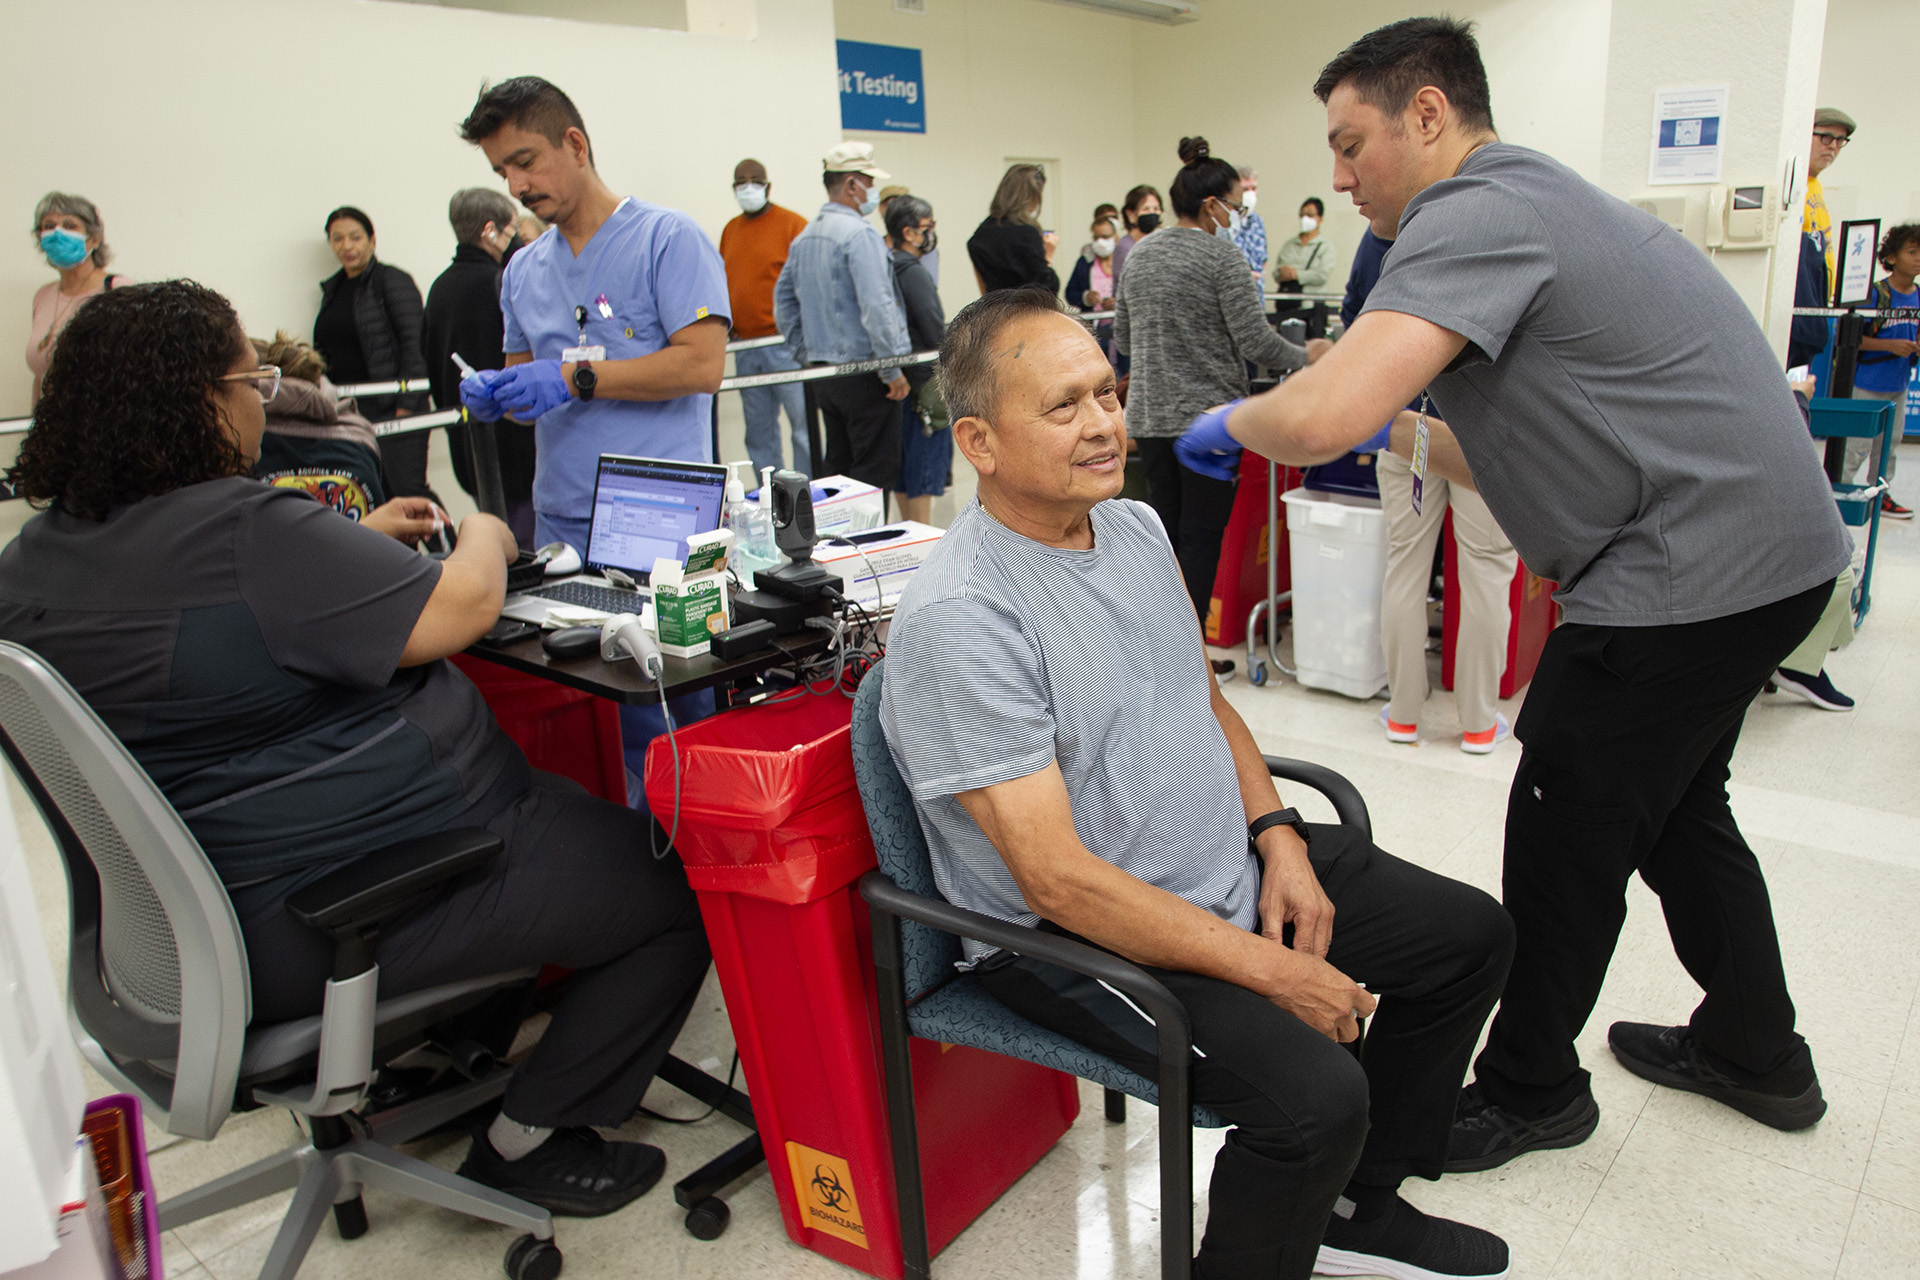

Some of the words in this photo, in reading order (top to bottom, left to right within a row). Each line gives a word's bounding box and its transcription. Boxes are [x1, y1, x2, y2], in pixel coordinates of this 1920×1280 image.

[852, 70, 917, 104] Testing
[1876, 309, 1906, 317] KEEP
[835, 361, 856, 374] KEEP
[857, 358, 880, 371] YOUR
[881, 355, 918, 368] DISTANCE
[333, 467, 353, 480] TEAM
[698, 542, 720, 553] CURAD
[658, 585, 677, 595] CURAD
[689, 581, 713, 594] CURAD
[685, 605, 700, 614] PLASTIC
[809, 1206, 865, 1235] BIOHAZARD
